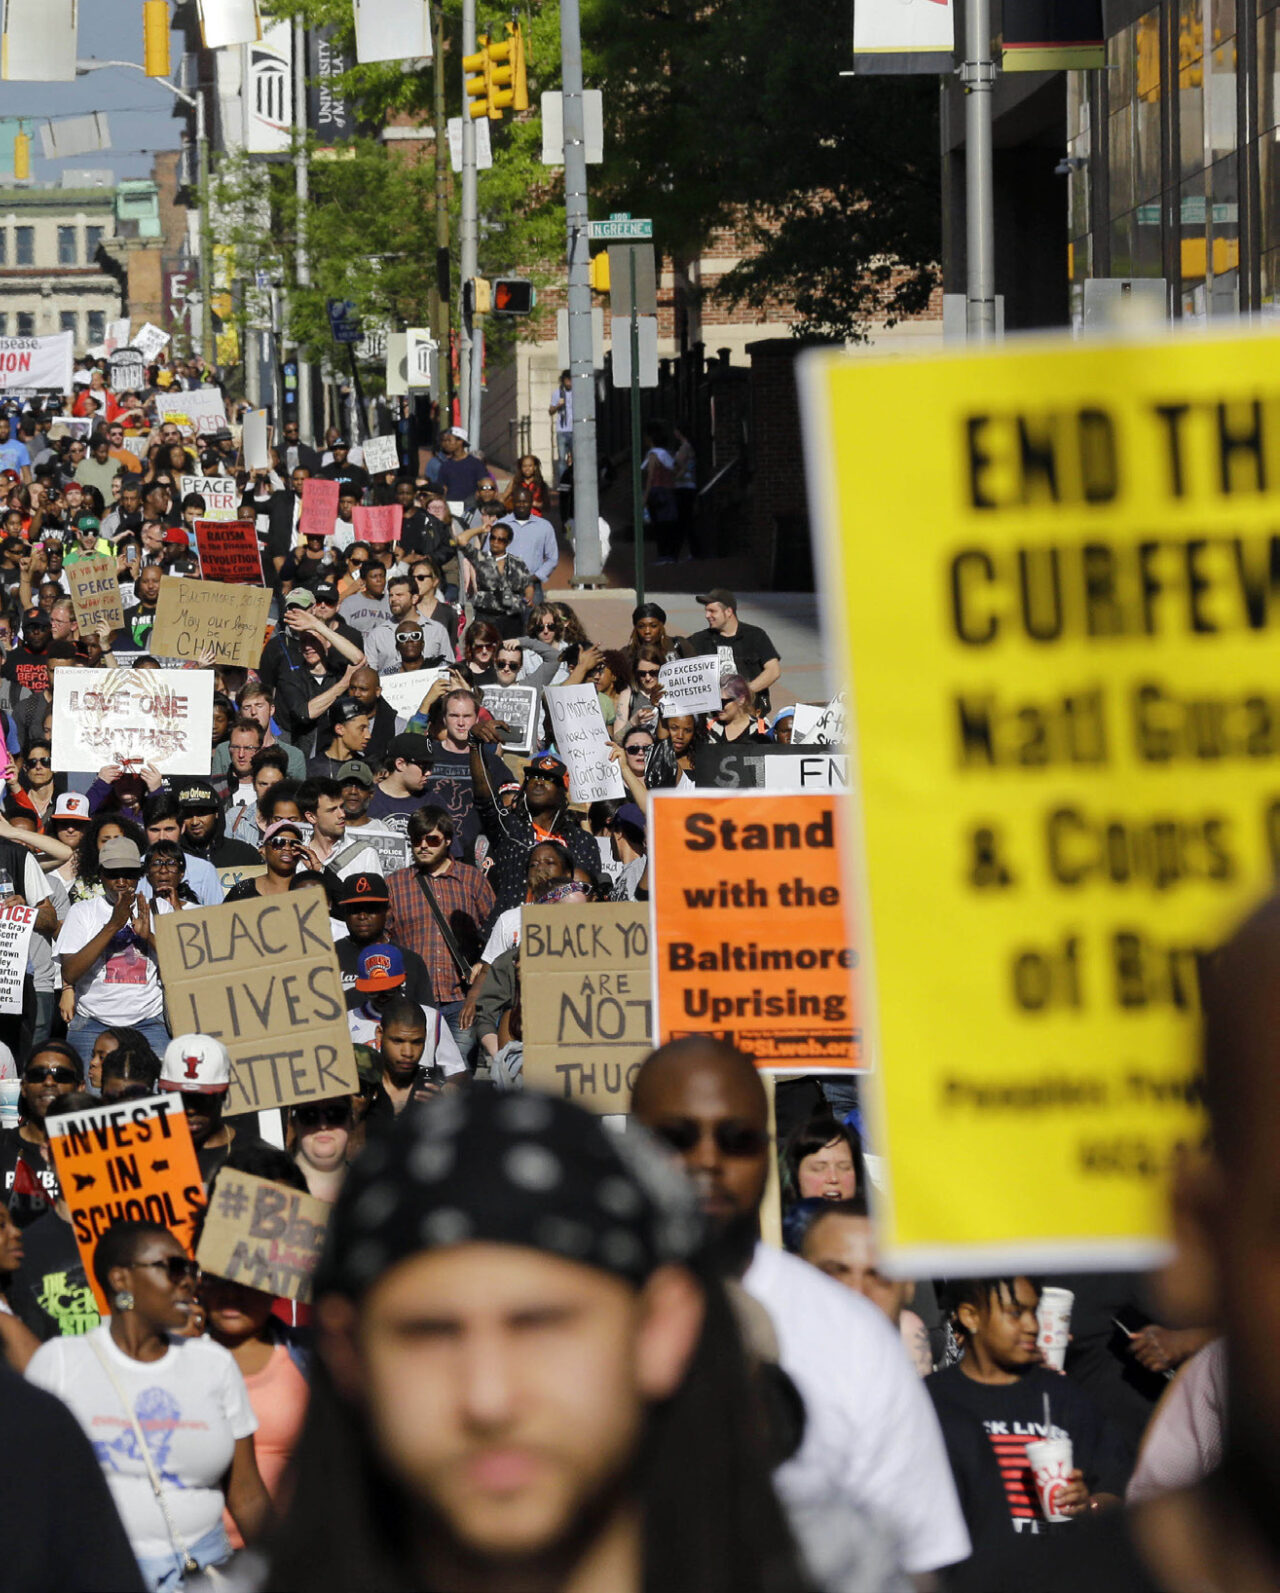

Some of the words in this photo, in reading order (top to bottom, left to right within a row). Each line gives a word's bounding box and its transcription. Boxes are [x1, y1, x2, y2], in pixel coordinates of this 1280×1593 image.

[604, 223, 643, 236] GREENE
[963, 408, 1119, 510] END
[183, 479, 234, 494] PEACE
[207, 530, 245, 541] RACISM
[202, 553, 258, 565] REVOLUTION
[78, 578, 116, 597] PEACE
[79, 607, 121, 630] JUSTICE
[173, 609, 201, 631] May
[208, 616, 229, 632] our
[232, 616, 258, 639] legacy
[177, 632, 242, 661] CHANGE
[207, 630, 220, 639] be
[669, 677, 686, 688] BAIL
[687, 674, 704, 685] FOR
[674, 661, 716, 676] EXCESSIVE
[70, 690, 131, 716] LOVE
[139, 694, 188, 718] ONE
[664, 684, 712, 699] PROTESTERS
[589, 728, 605, 741] you
[595, 761, 620, 784] Stop
[576, 789, 589, 801] us
[591, 787, 608, 798] now
[684, 810, 835, 852] Stand
[379, 848, 403, 856] POLICE
[1046, 806, 1233, 892] Cops
[683, 879, 768, 909] with
[778, 878, 840, 908] the
[8, 921, 26, 934] Gray
[175, 900, 332, 970] BLACK
[525, 922, 612, 959] BLACK
[668, 941, 860, 972] Baltimore
[581, 973, 631, 997] ARE
[188, 965, 343, 1038] LIVES
[683, 988, 846, 1023] Uprising
[557, 991, 652, 1043] NOT
[224, 1043, 350, 1110] ATTER
[60, 1102, 171, 1158] INVEST
[105, 1154, 142, 1194] IN
[72, 1186, 207, 1244] SCHOOLS
